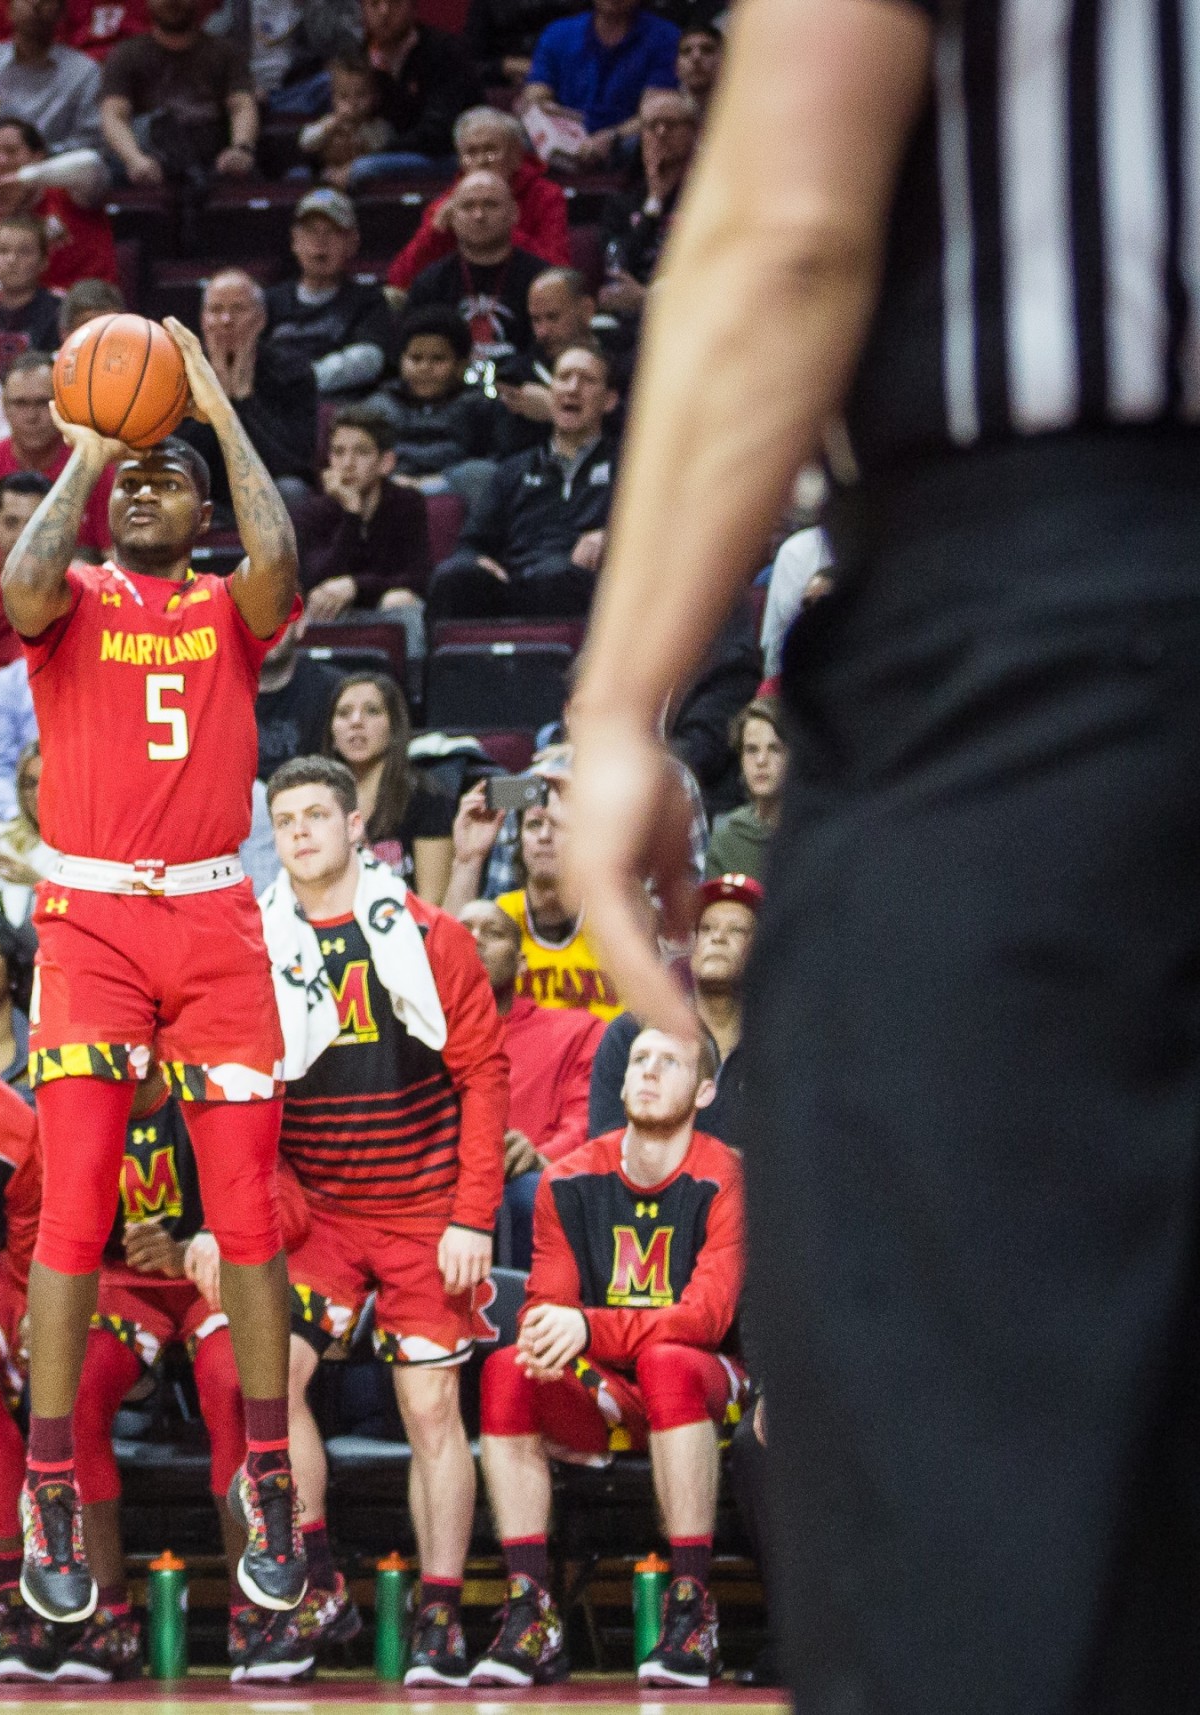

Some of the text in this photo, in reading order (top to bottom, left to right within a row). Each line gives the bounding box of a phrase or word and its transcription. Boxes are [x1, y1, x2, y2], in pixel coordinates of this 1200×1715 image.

[100, 626, 218, 666] MARYLAND
[145, 673, 189, 761] 5
[119, 1145, 182, 1221] M
[607, 1224, 673, 1297] M
